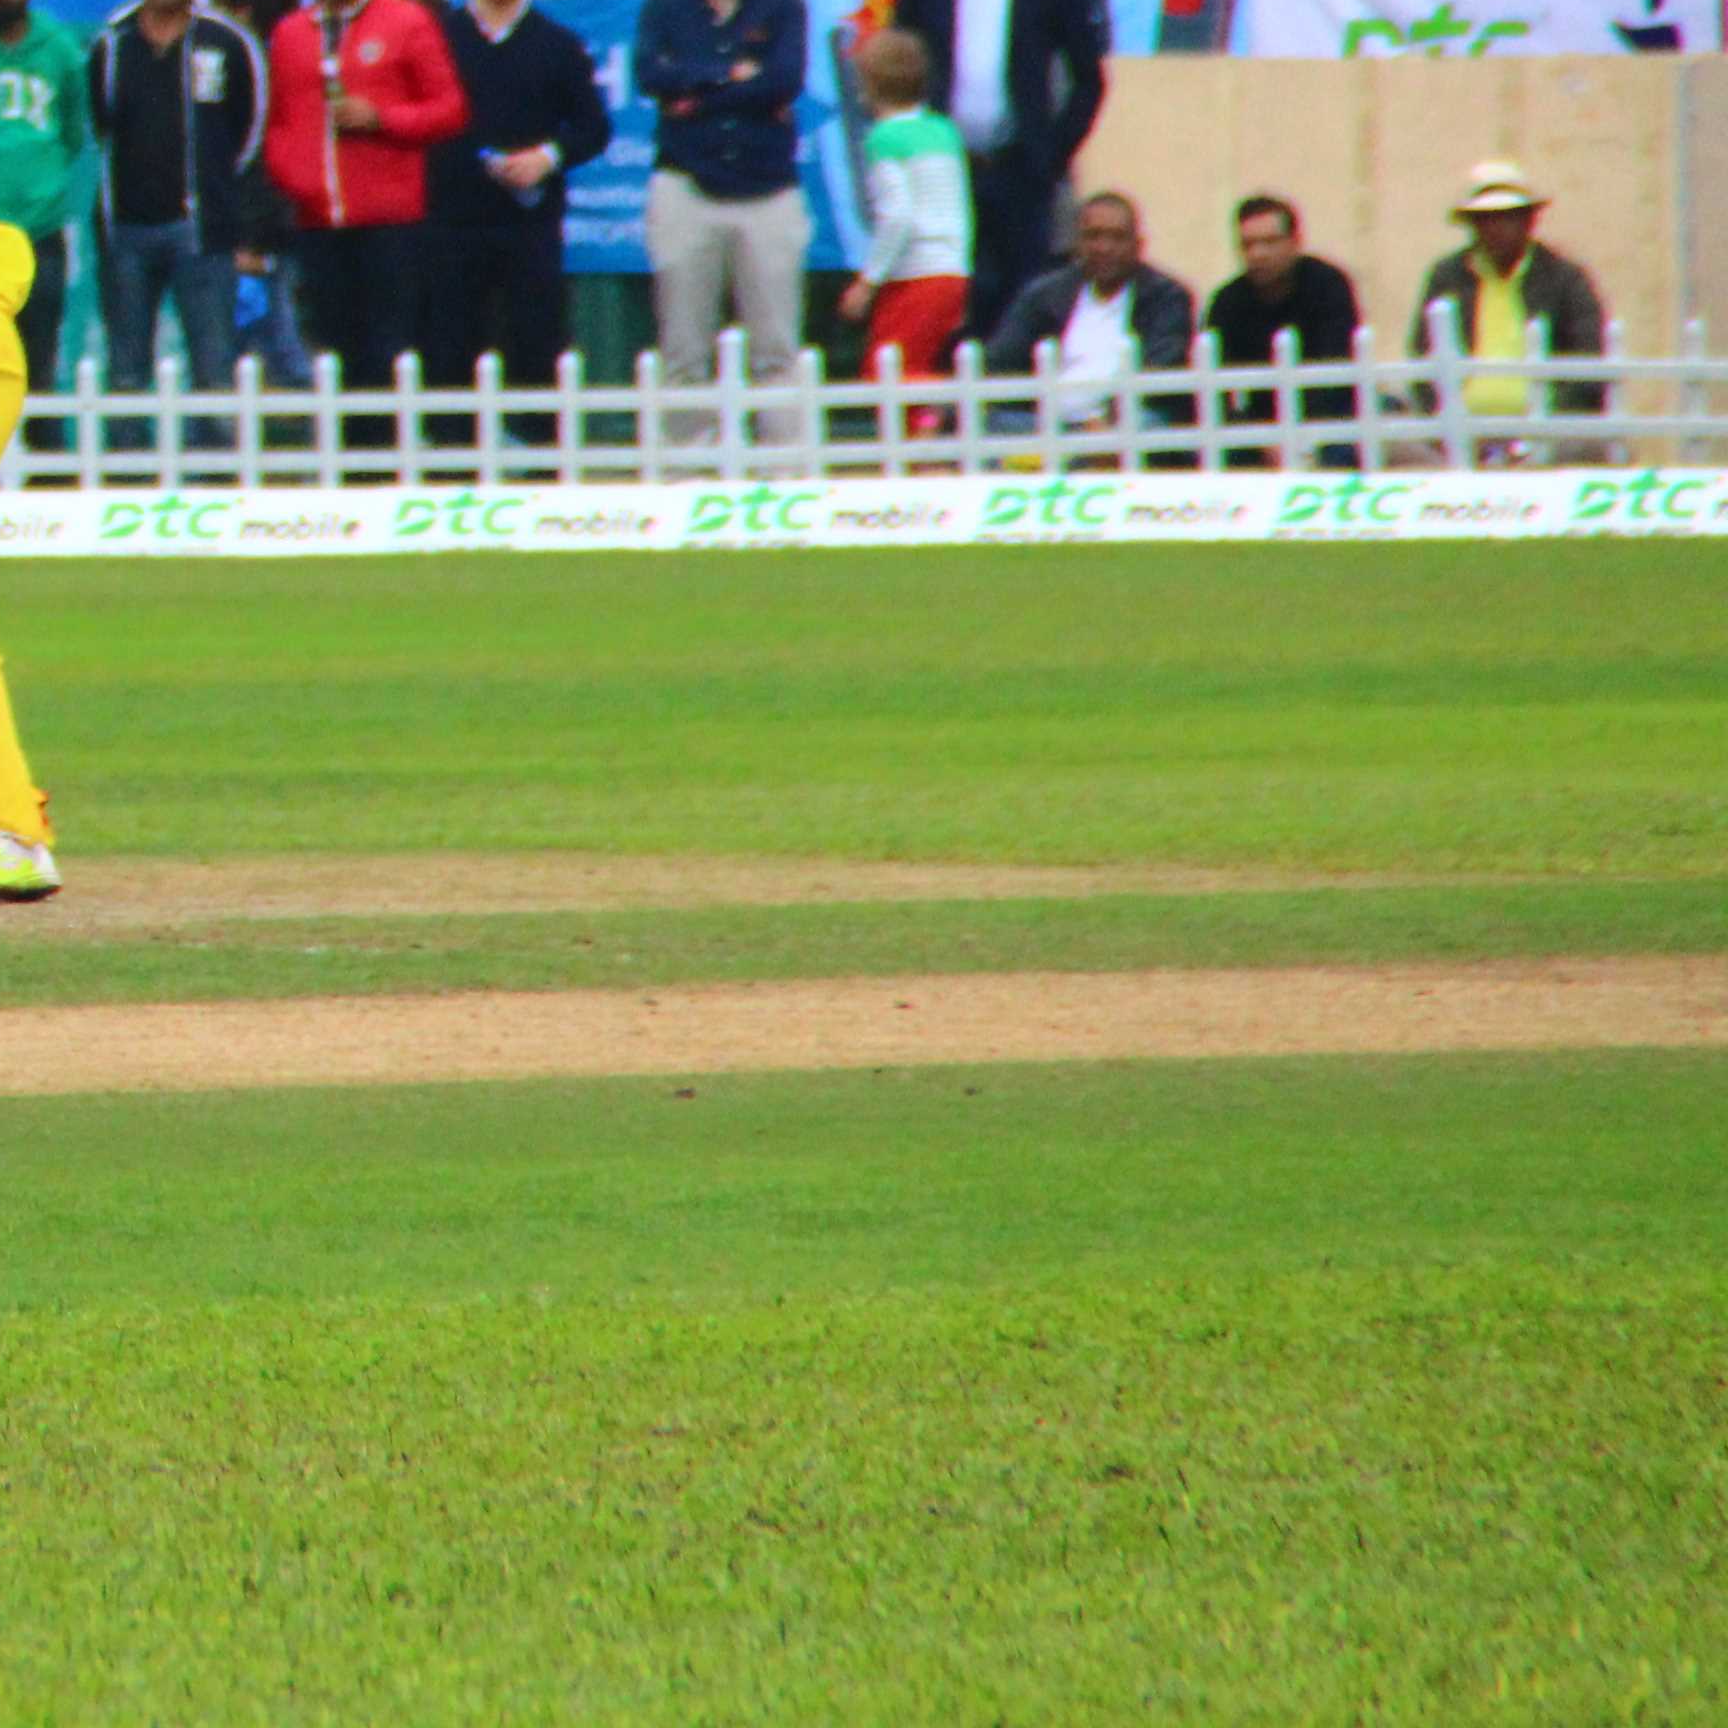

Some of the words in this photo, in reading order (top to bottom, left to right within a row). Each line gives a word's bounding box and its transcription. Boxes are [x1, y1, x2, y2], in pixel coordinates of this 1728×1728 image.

[240, 510, 361, 538] mobile
[535, 507, 654, 534] mobile
[829, 502, 949, 530] mobile
[1125, 498, 1246, 524] mobile
[1419, 496, 1539, 522] mobile
